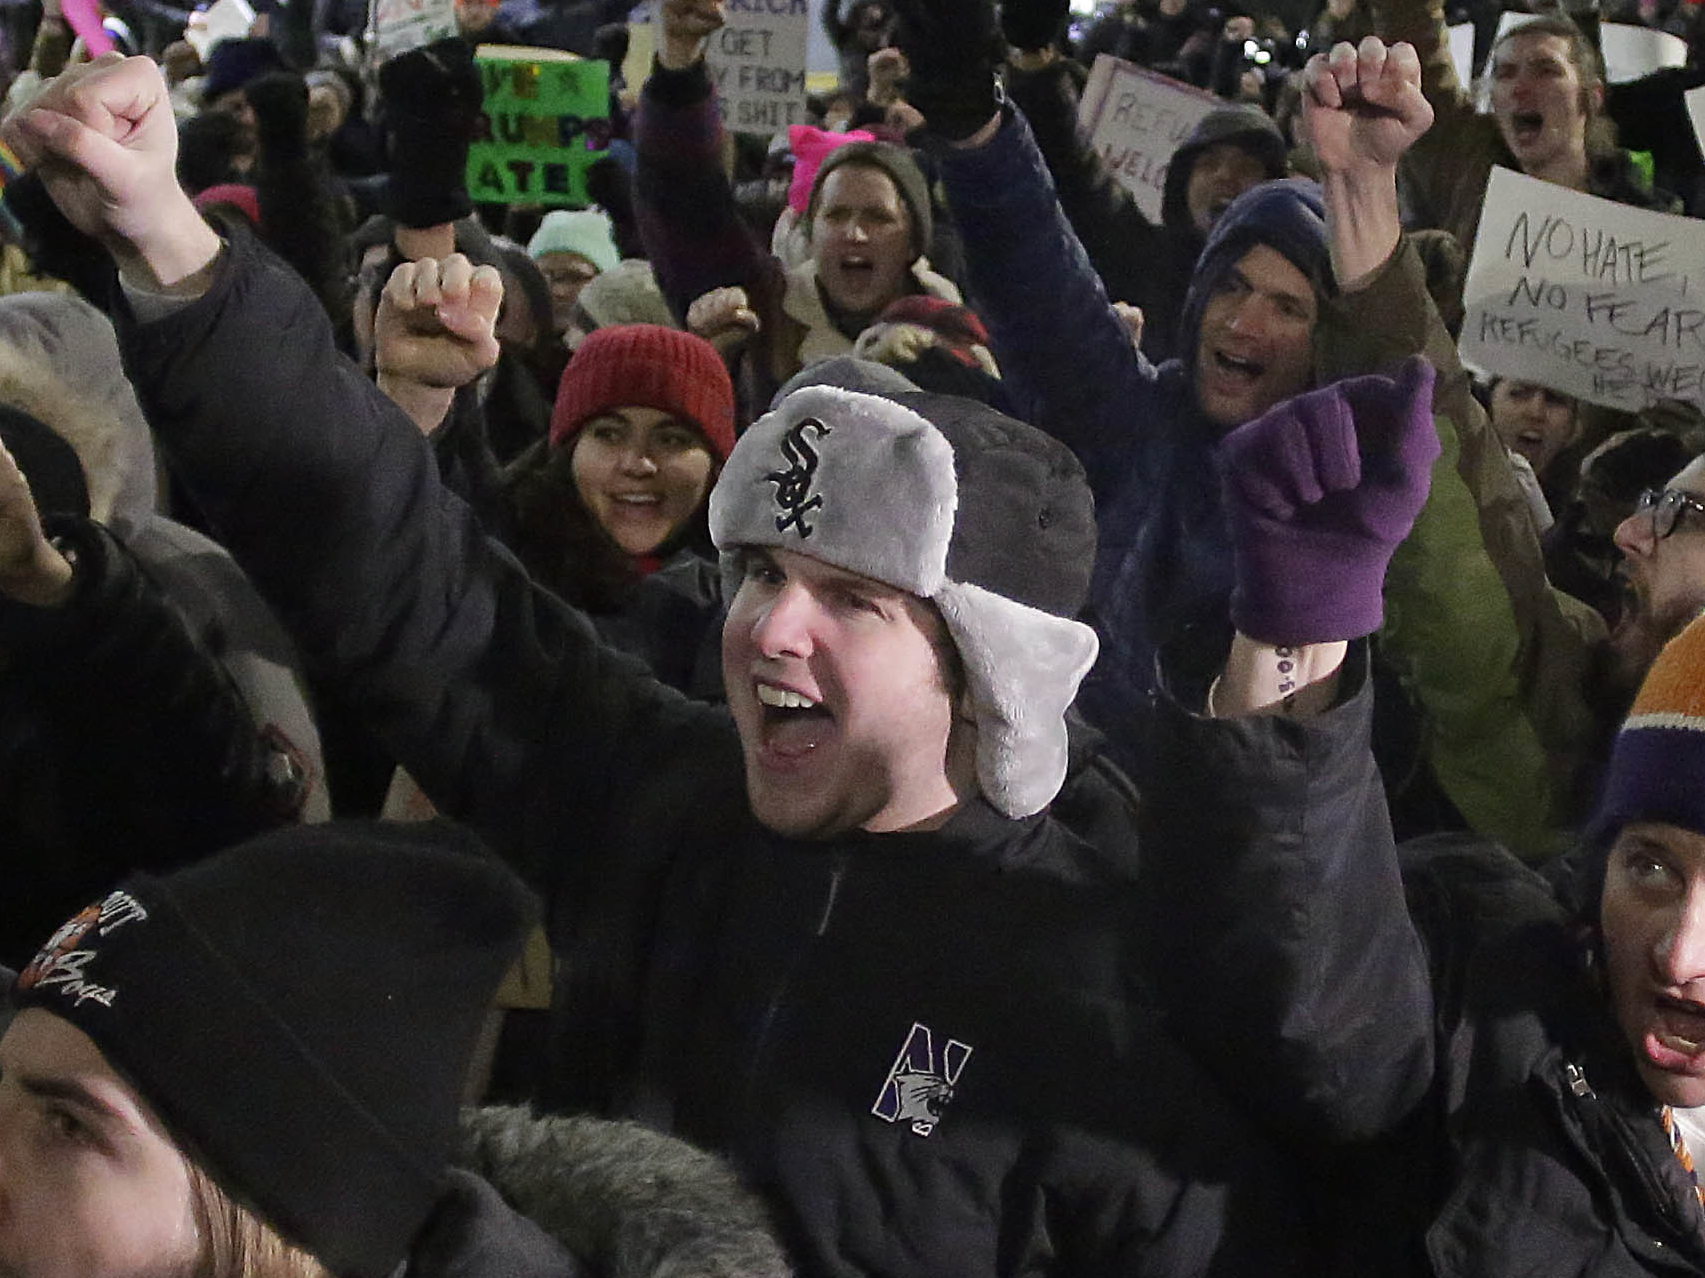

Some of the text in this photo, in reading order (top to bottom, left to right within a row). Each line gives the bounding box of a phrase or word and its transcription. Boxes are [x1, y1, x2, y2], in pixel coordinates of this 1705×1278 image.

[1112, 92, 1191, 143] REFU
[476, 159, 570, 196] ATE
[1505, 211, 1575, 269] NO
[1508, 275, 1568, 311] NO
